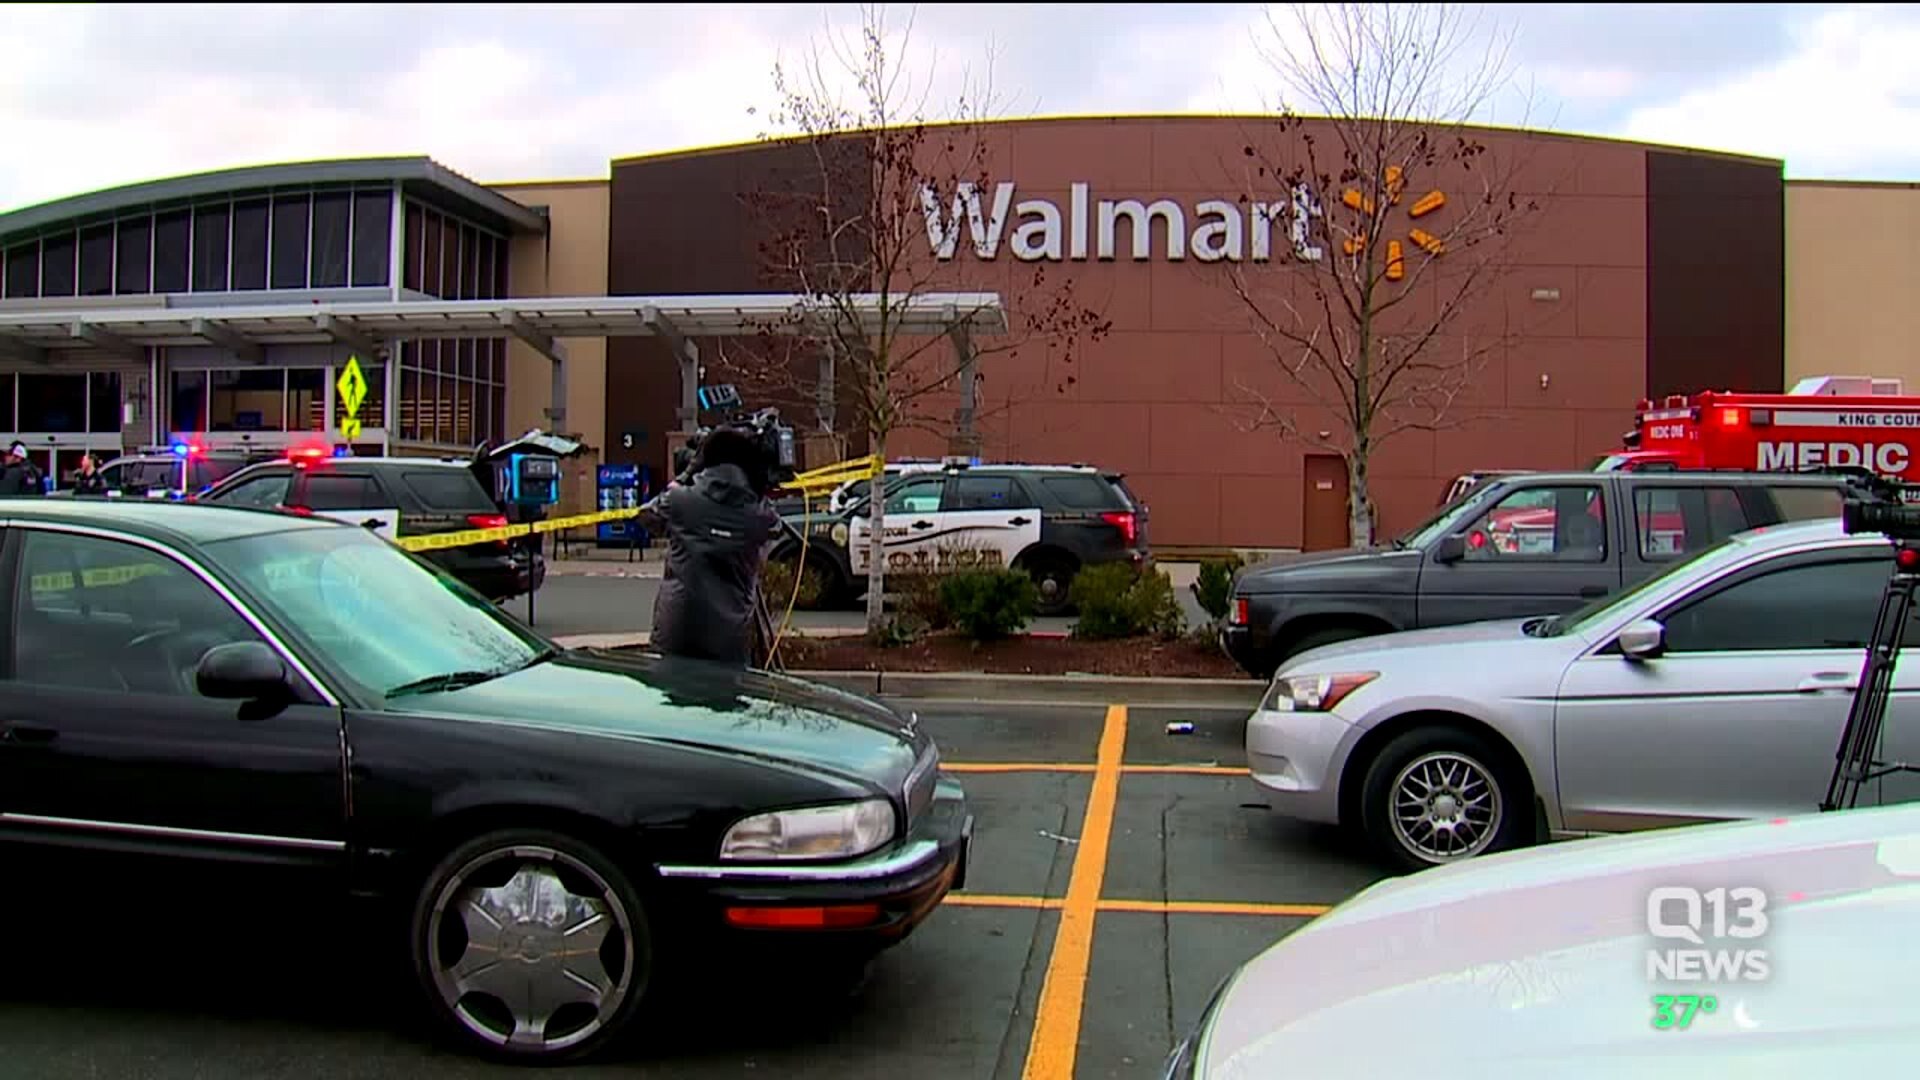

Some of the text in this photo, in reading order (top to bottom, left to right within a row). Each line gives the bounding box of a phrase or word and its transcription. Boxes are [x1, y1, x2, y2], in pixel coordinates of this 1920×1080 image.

[919, 182, 1322, 261] Walmart
[1839, 414, 1876, 425] KING
[624, 434, 632, 447] 3
[1757, 441, 1909, 473] MEDIC
